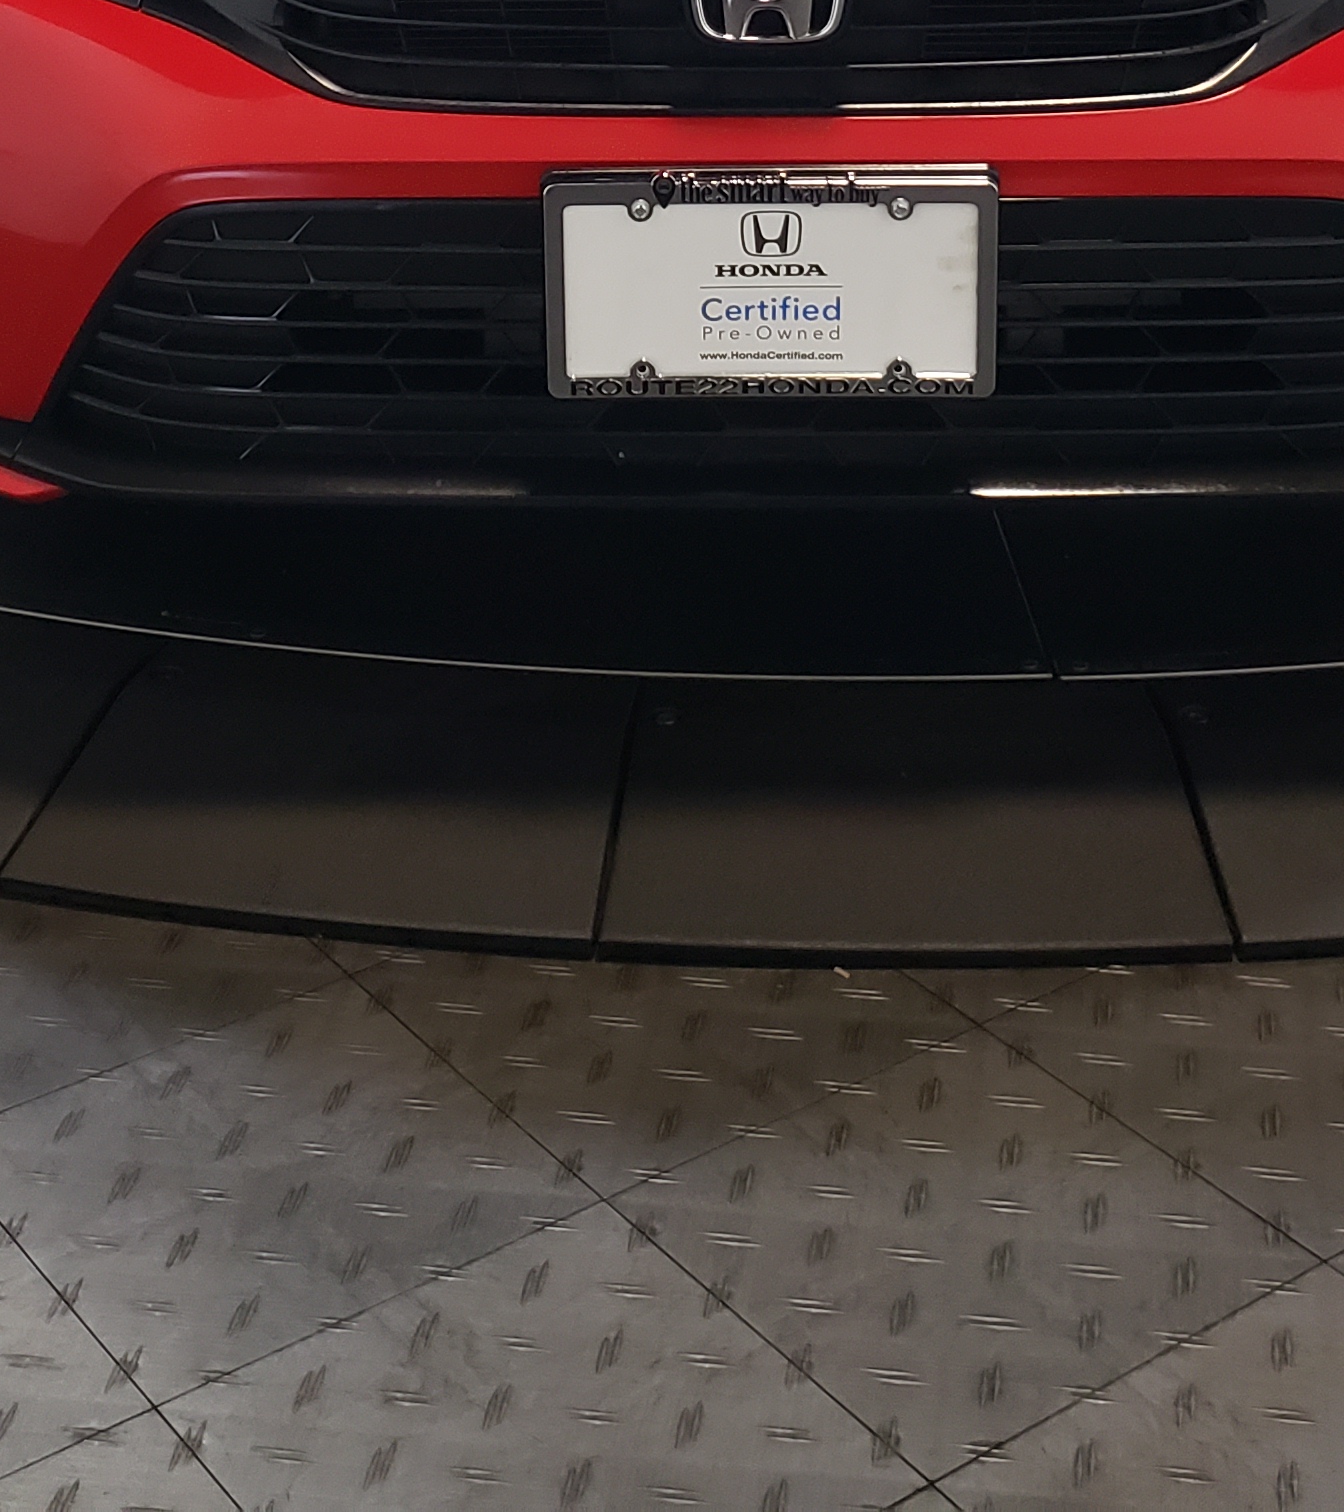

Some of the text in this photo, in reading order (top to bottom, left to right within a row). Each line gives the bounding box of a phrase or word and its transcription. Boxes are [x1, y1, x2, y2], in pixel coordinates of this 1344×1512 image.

[790, 184, 823, 207] way
[714, 263, 828, 278] HONDA
[701, 296, 841, 322] Certified
[702, 325, 841, 341] Pre-Owned
[699, 350, 844, 361] www.HondaCertified.com
[570, 377, 975, 397] ROUTE22HONDA.COM
